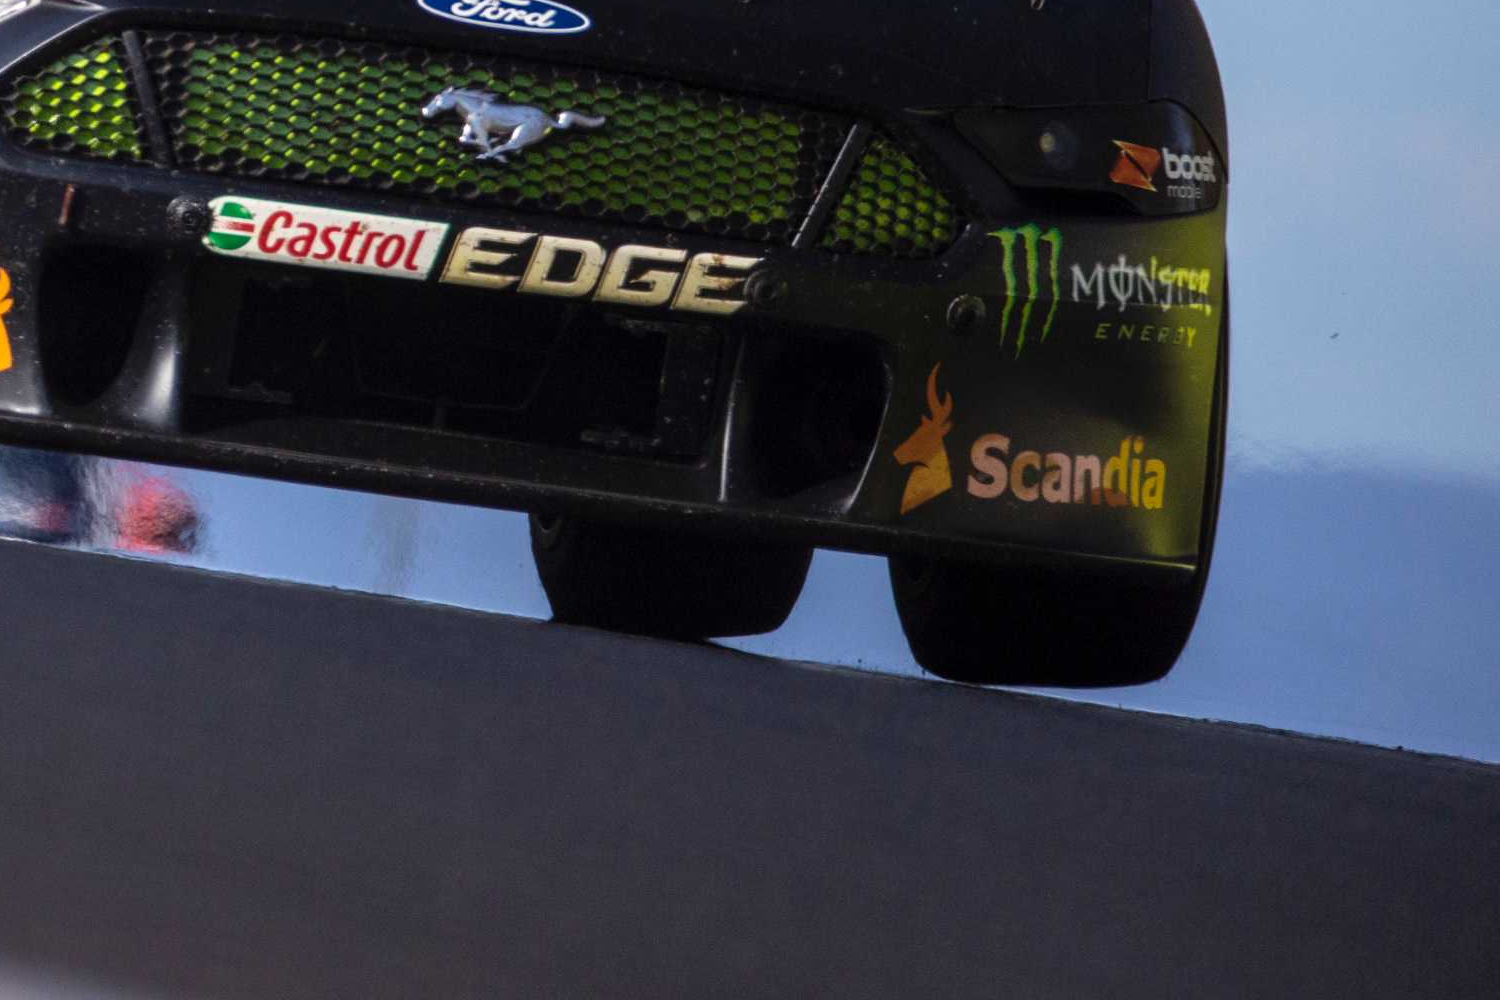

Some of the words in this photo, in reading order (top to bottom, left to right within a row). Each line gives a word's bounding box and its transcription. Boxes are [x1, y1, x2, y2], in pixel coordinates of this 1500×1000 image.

[1162, 146, 1217, 184] boost
[257, 209, 421, 273] Castrol
[438, 226, 766, 316] EDGE
[1070, 253, 1212, 317] MONSTER
[1095, 322, 1197, 349] ENERGY
[966, 432, 1167, 511] Scandia
